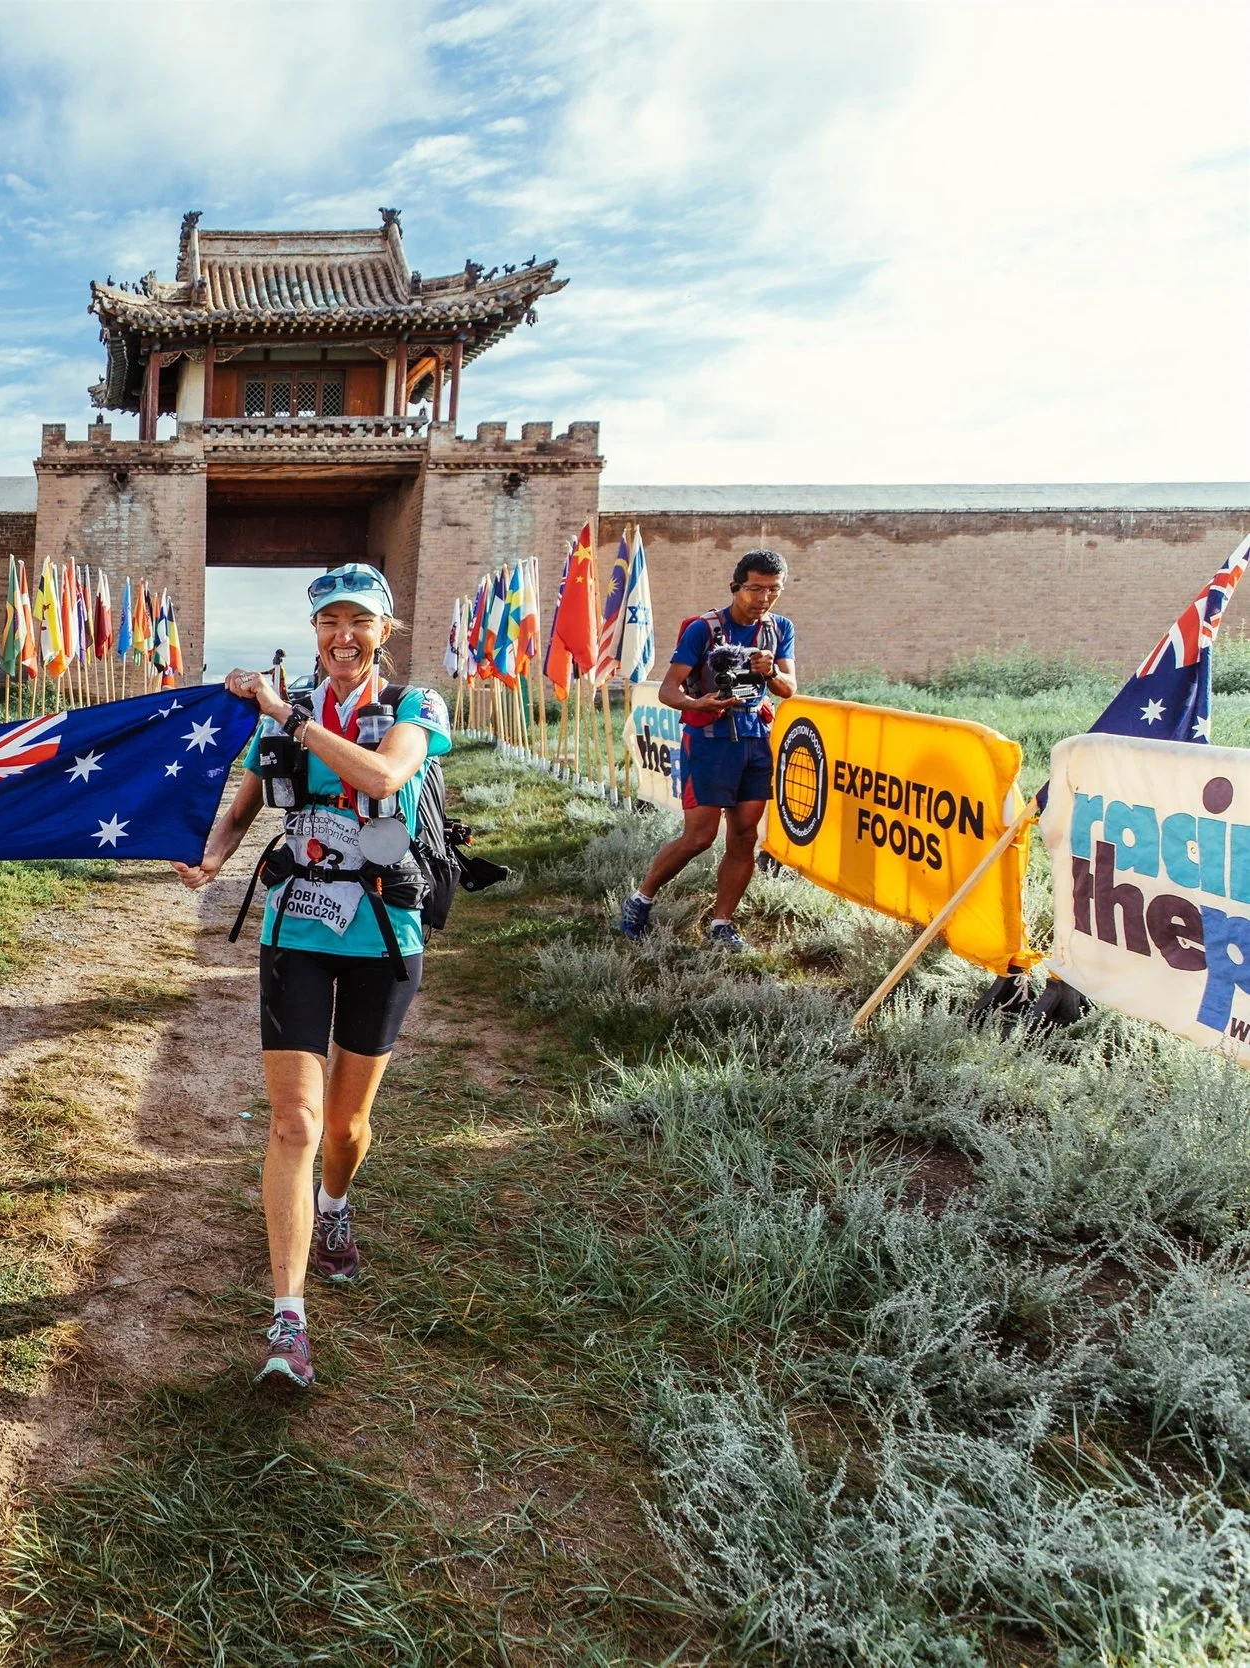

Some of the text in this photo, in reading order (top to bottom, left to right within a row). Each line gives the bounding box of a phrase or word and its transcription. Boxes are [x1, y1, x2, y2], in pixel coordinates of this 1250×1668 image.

[784, 725, 823, 759] EXPEDITION FOODS
[833, 760, 984, 840] EXPEDITION
[857, 808, 942, 870] FOODS
[321, 908, 348, 928] 2018
